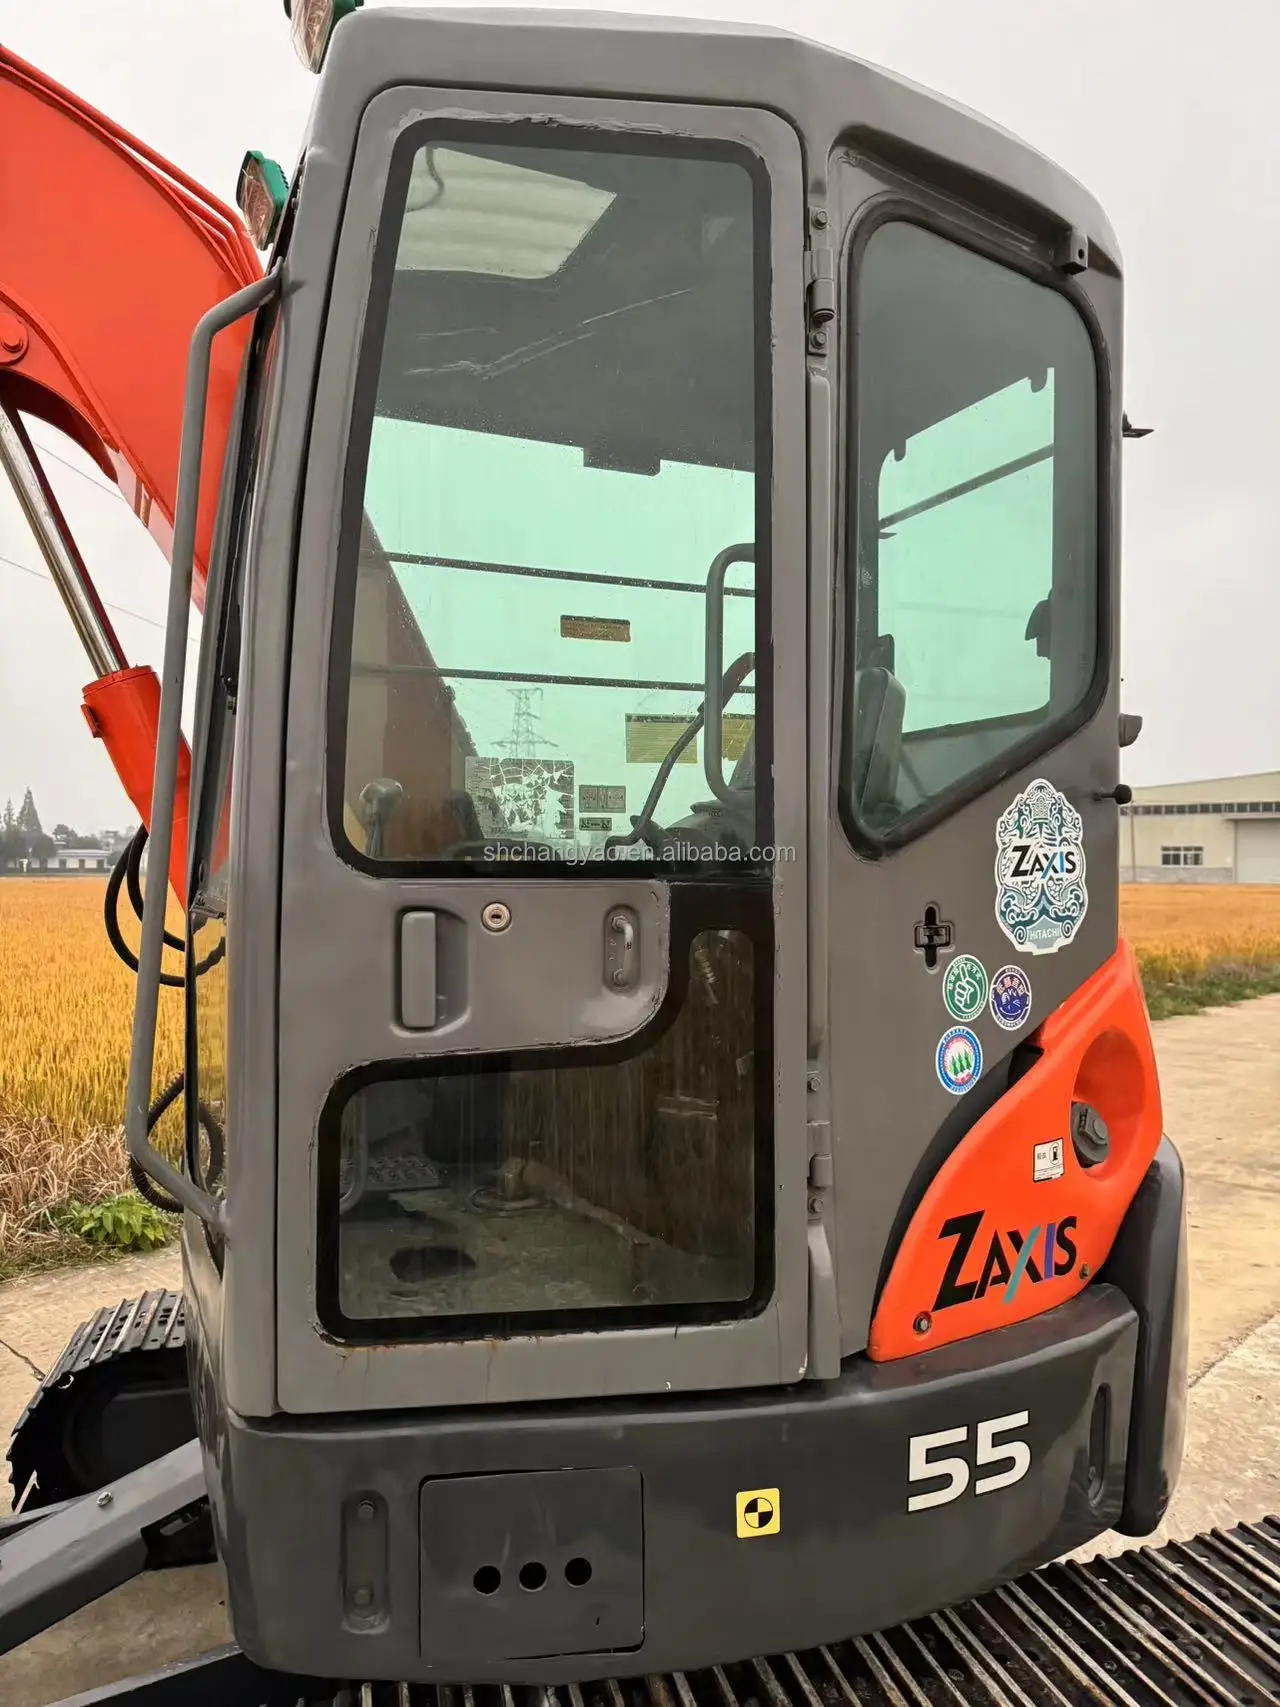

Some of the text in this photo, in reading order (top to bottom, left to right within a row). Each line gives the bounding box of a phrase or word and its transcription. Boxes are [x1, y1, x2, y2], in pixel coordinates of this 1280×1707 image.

[1010, 844, 1077, 880] ZAXIS
[1029, 927, 1061, 940] HITACHI
[930, 1209, 1078, 1313] ZAXIS
[907, 1408, 1032, 1513] 55
